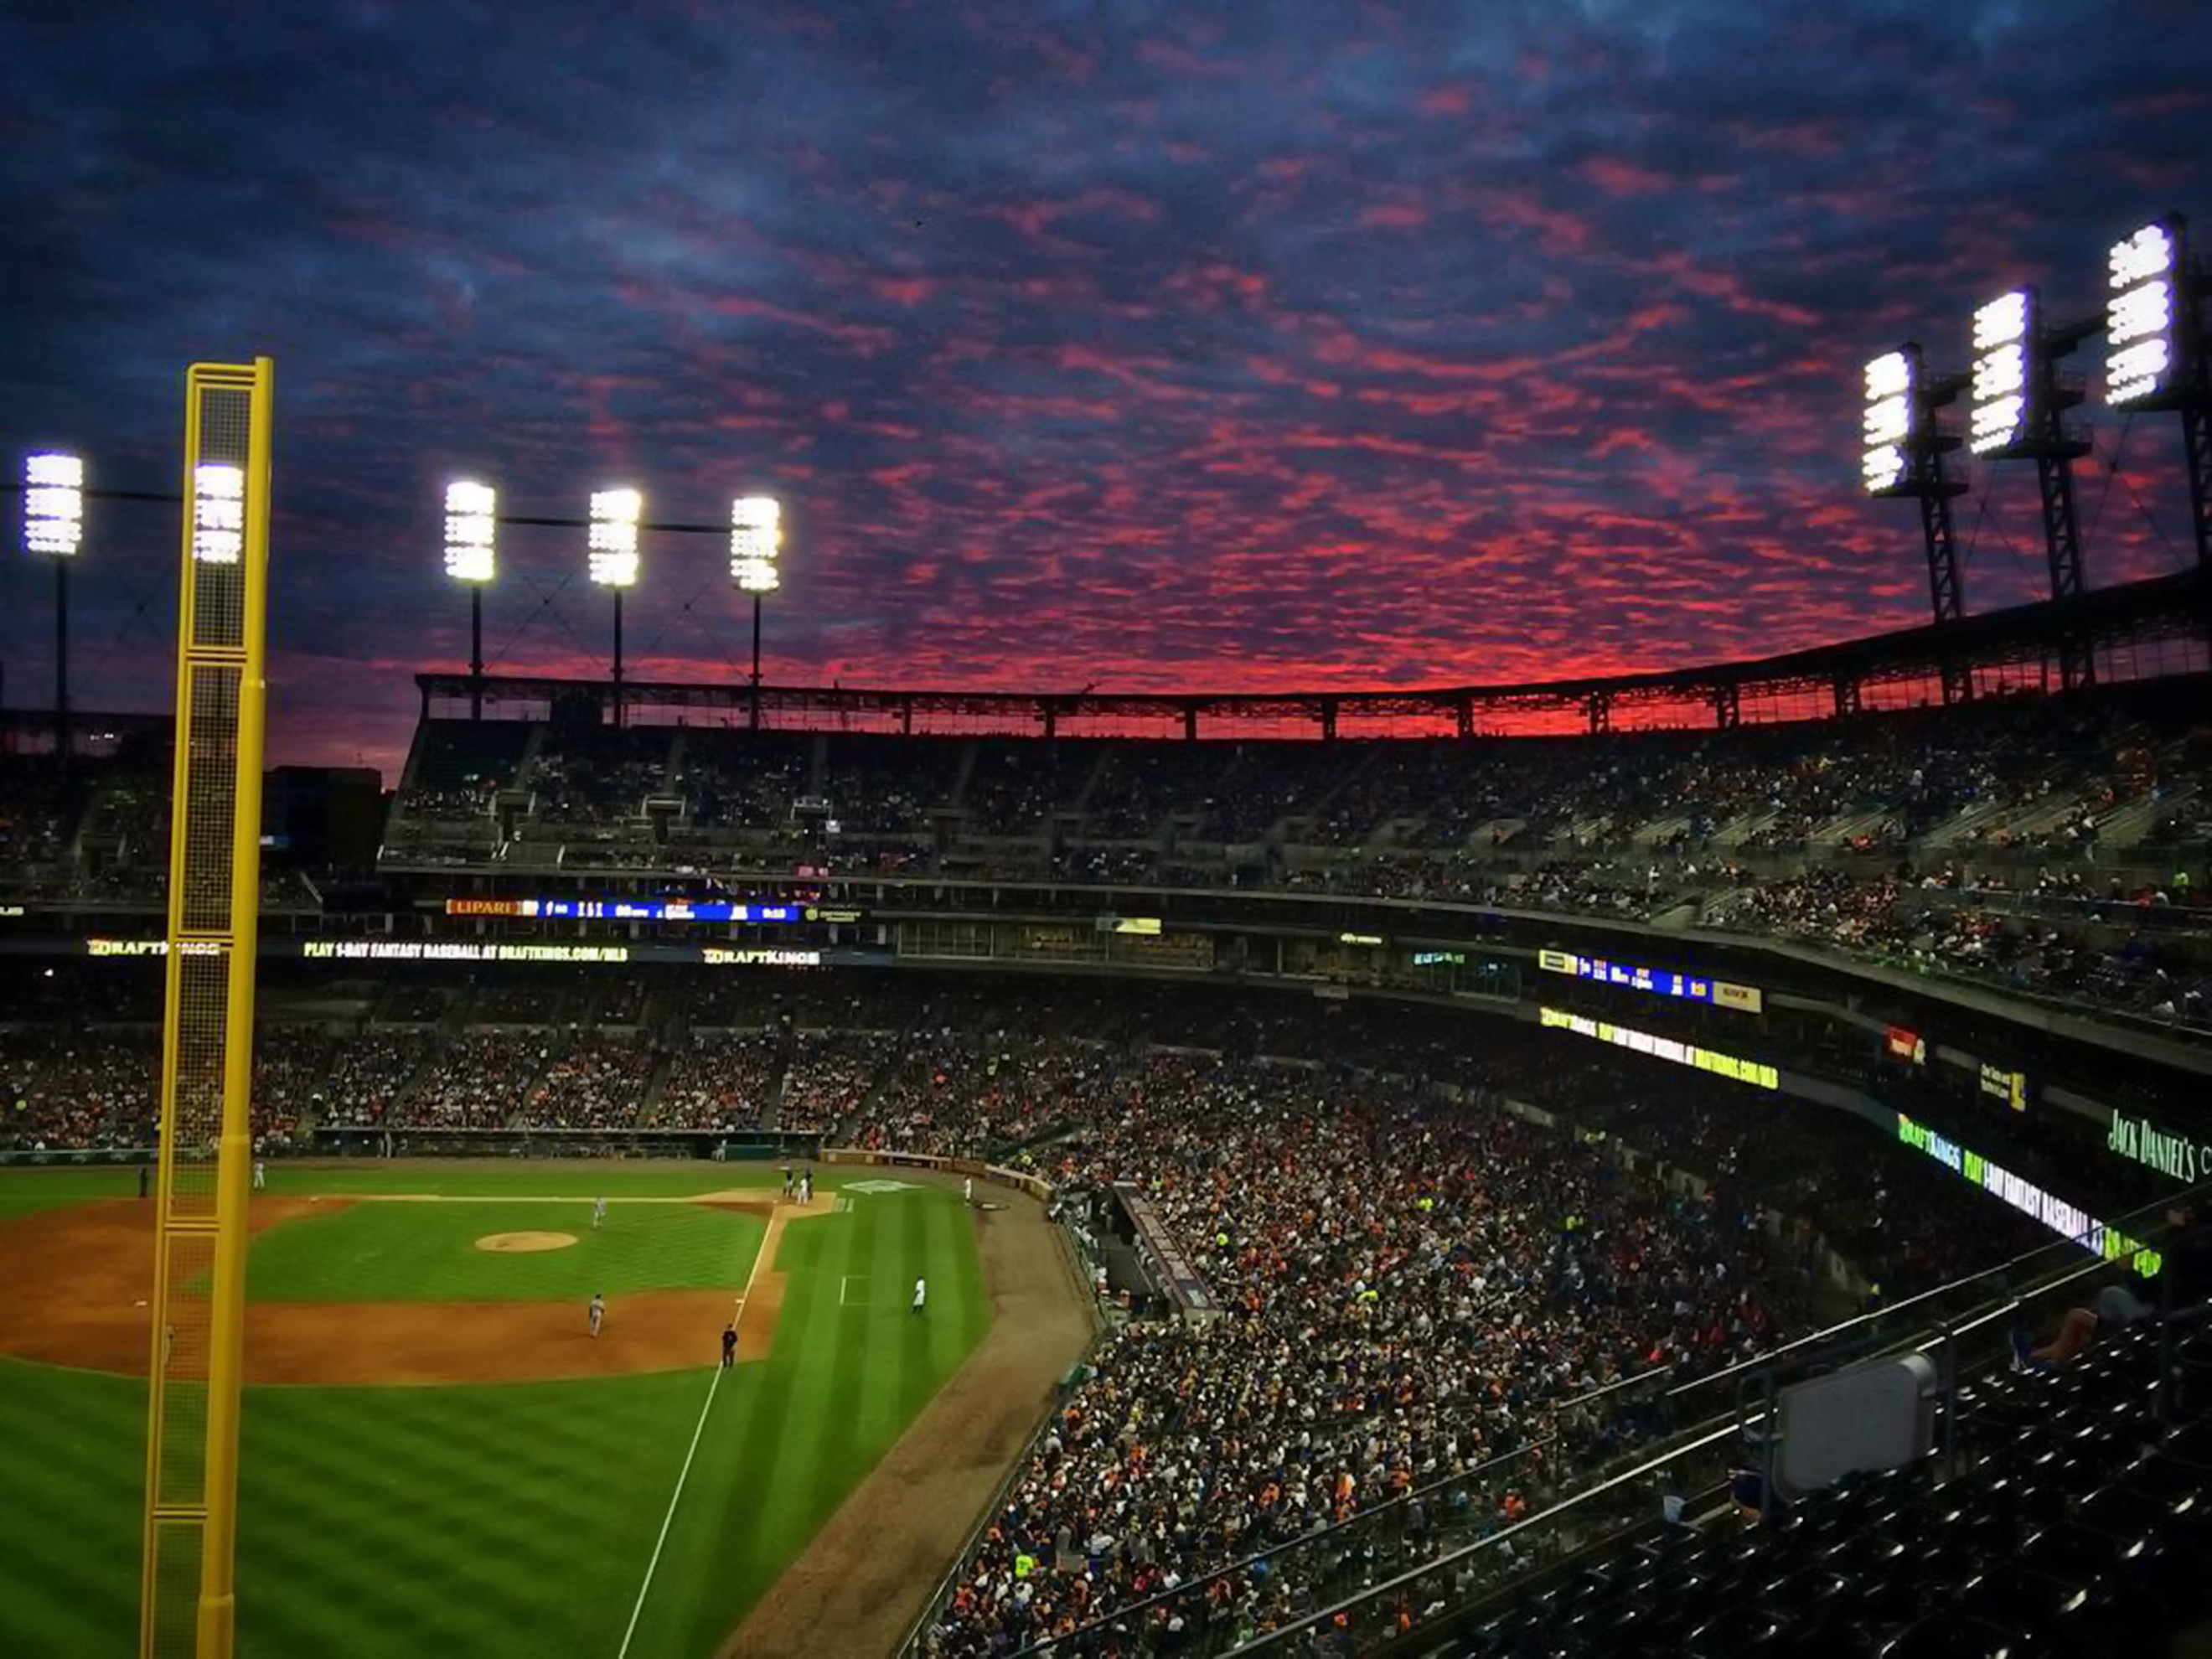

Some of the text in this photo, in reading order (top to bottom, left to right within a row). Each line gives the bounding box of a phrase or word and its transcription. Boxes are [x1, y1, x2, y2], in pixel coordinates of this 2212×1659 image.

[456, 901, 512, 915] LIPARI
[303, 941, 334, 958] PLAY
[370, 942, 422, 959] FANTASY
[423, 943, 480, 960] BASEBALL
[482, 944, 498, 960] AT
[710, 948, 820, 964] DRAFTKINGS
